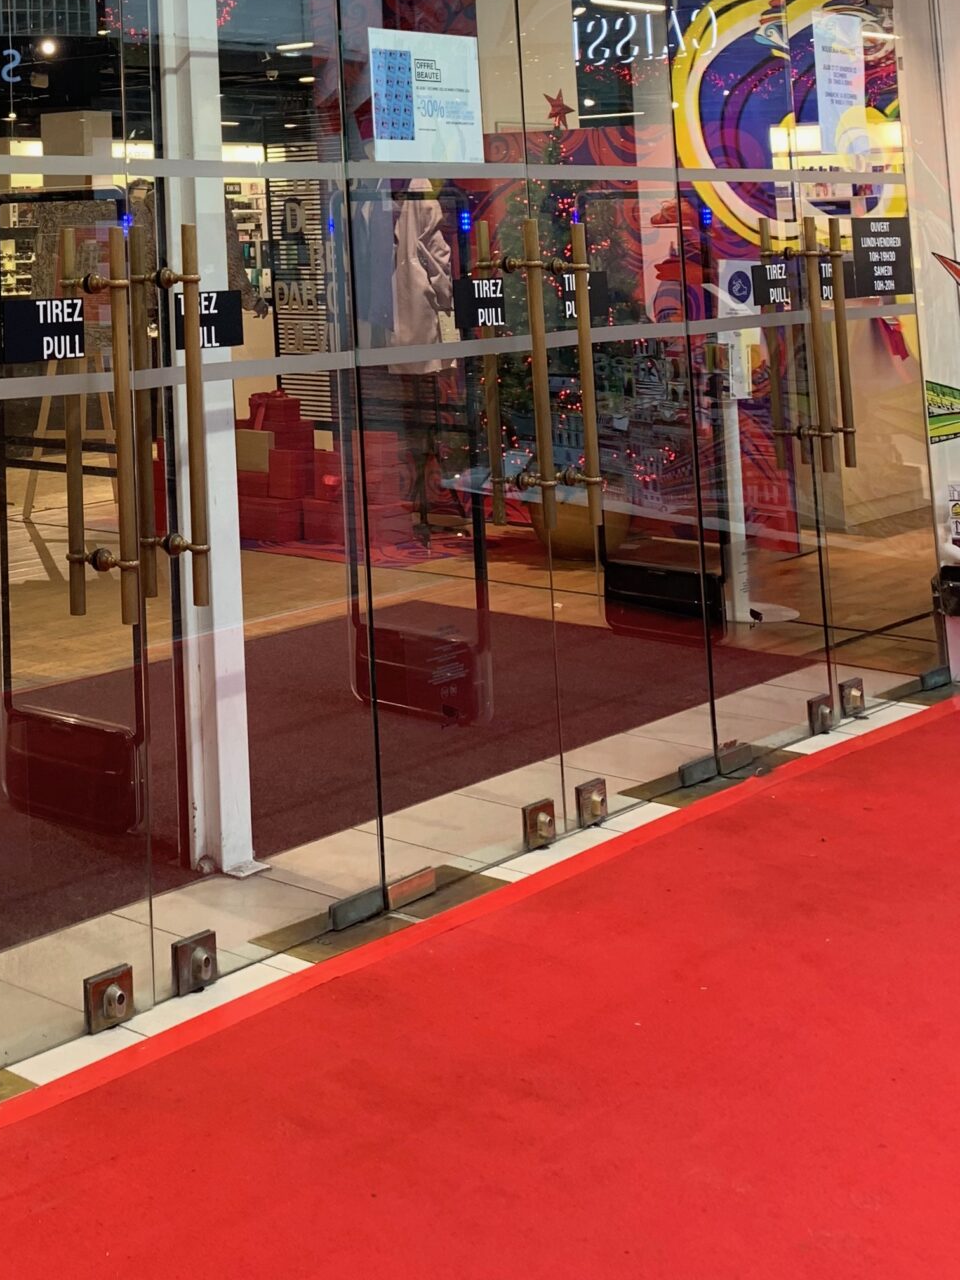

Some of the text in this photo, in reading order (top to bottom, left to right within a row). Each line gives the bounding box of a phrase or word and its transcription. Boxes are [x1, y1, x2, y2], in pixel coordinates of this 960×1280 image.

[820, 263, 833, 279] TIR
[472, 279, 503, 299] TIREZ
[822, 285, 834, 300] PU
[36, 299, 84, 324] TIREZ
[477, 307, 505, 327] PULL
[43, 334, 85, 360] PULL
